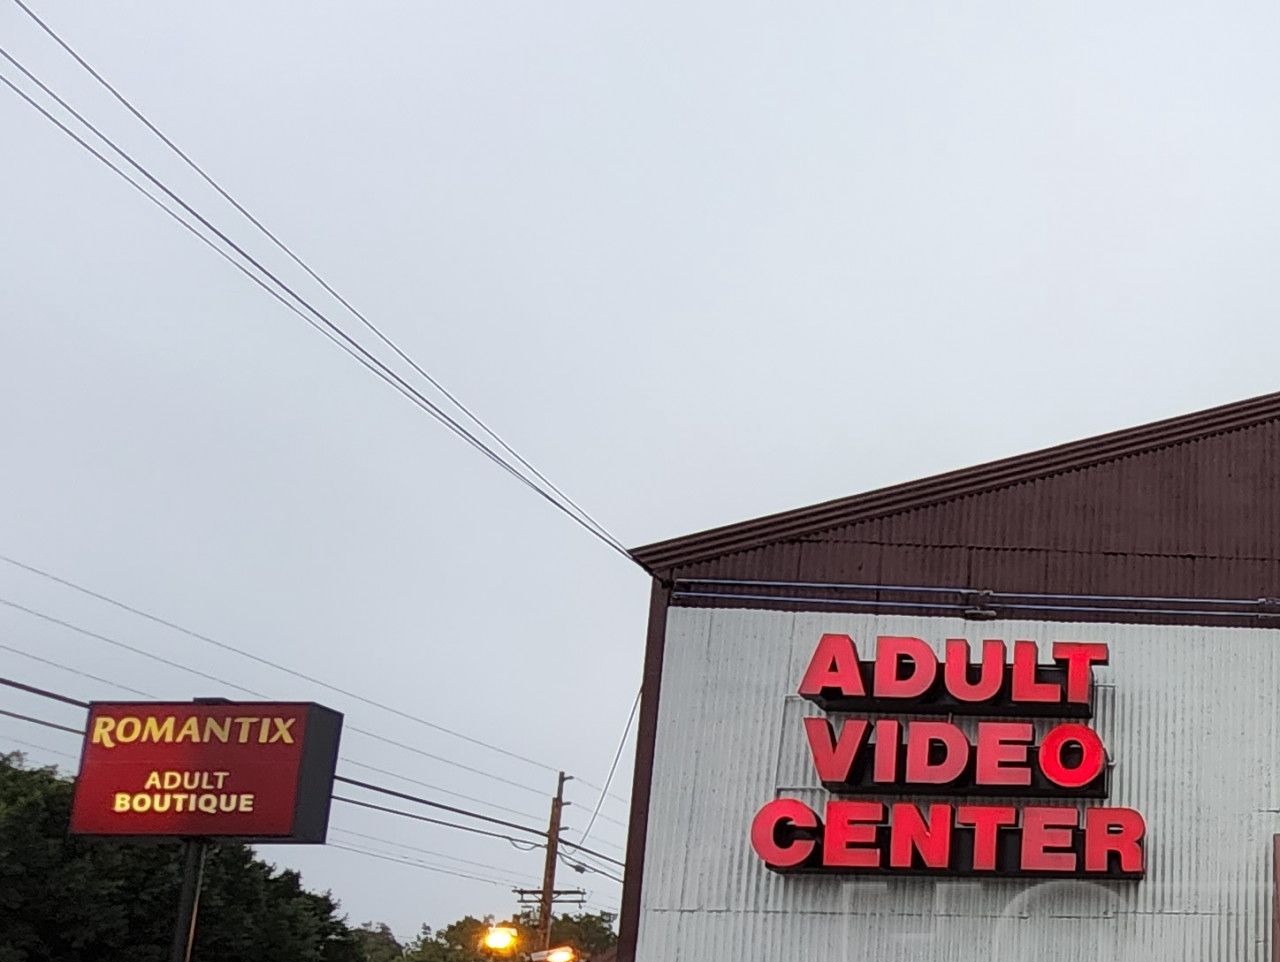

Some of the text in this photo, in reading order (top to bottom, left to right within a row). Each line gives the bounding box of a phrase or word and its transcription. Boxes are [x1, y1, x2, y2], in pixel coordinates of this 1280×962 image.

[798, 633, 1108, 703] ADULT
[91, 717, 296, 748] ROMANTIX
[803, 717, 1106, 787] VIDEO
[113, 793, 255, 814] BOUTIQUE
[144, 771, 230, 789] ADULT
[751, 799, 1147, 872] CENTER
